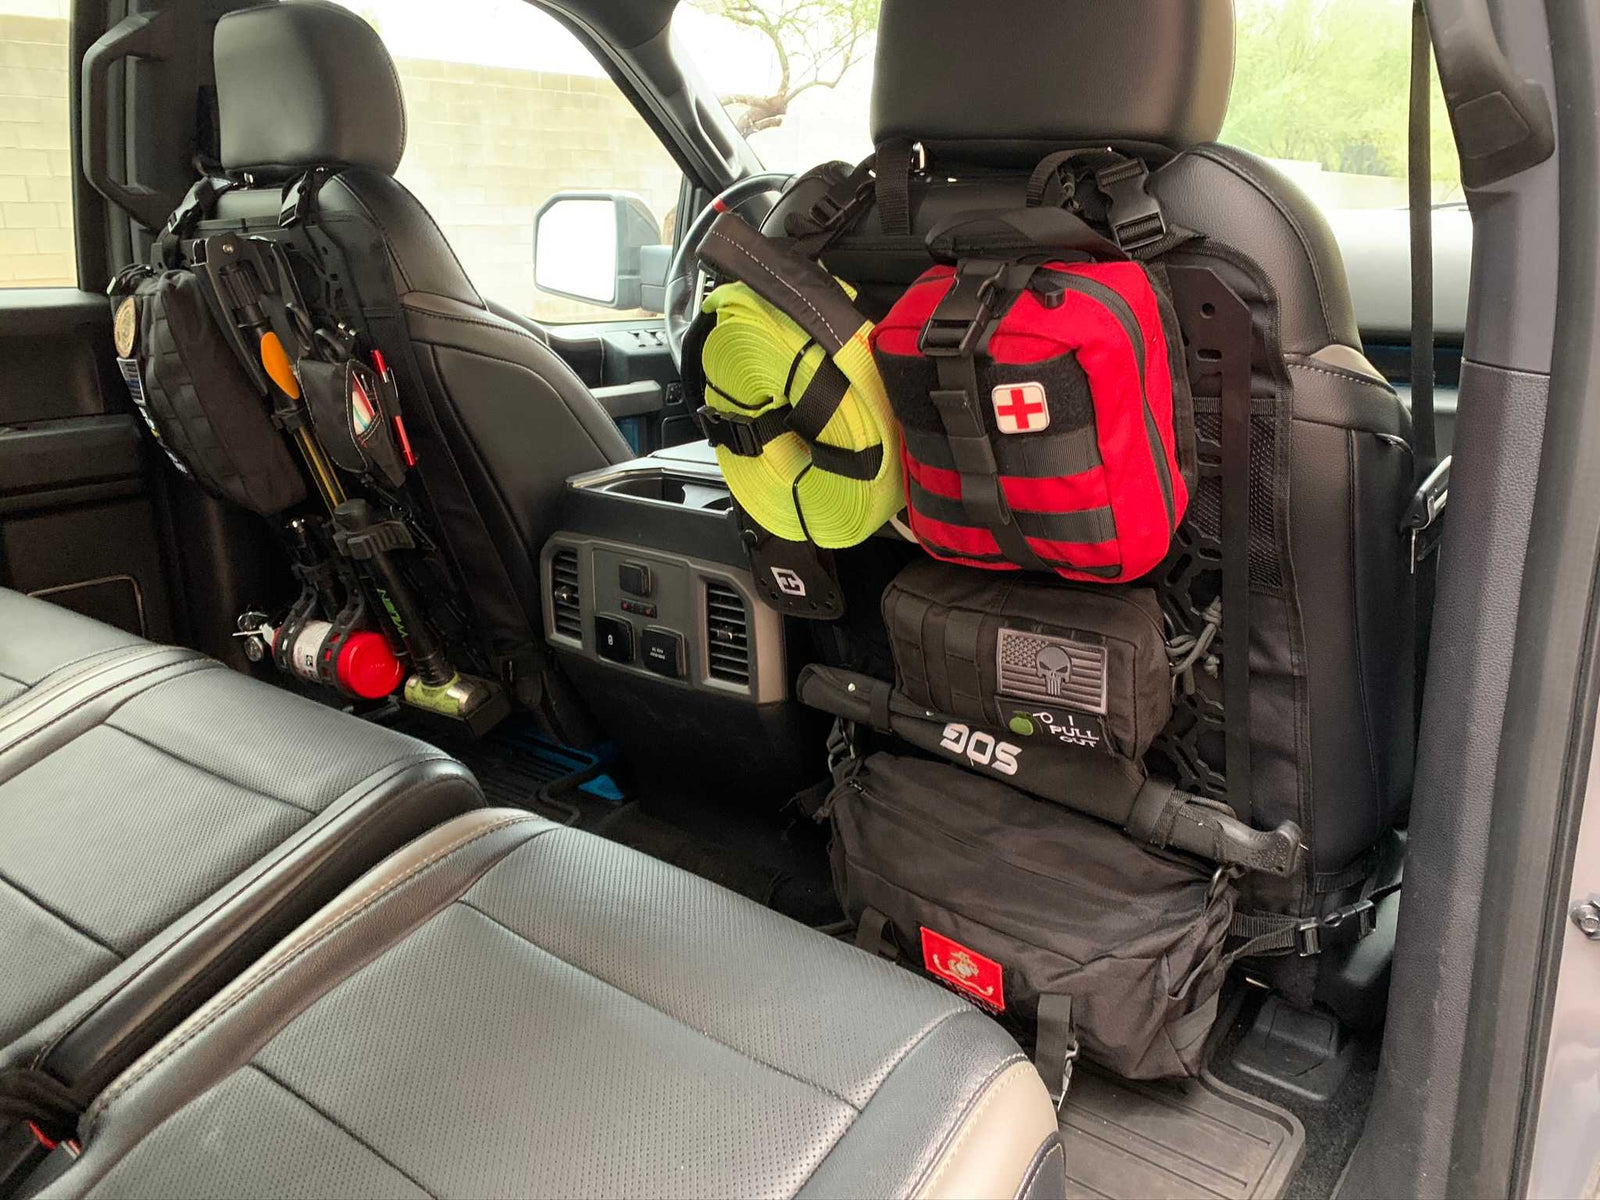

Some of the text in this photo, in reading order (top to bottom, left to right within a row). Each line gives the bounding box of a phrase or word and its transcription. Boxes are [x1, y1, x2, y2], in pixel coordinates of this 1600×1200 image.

[1068, 715, 1074, 726] I
[1049, 725, 1100, 741] PULL
[940, 723, 1022, 775] SOG
[1059, 736, 1097, 748] OUT
